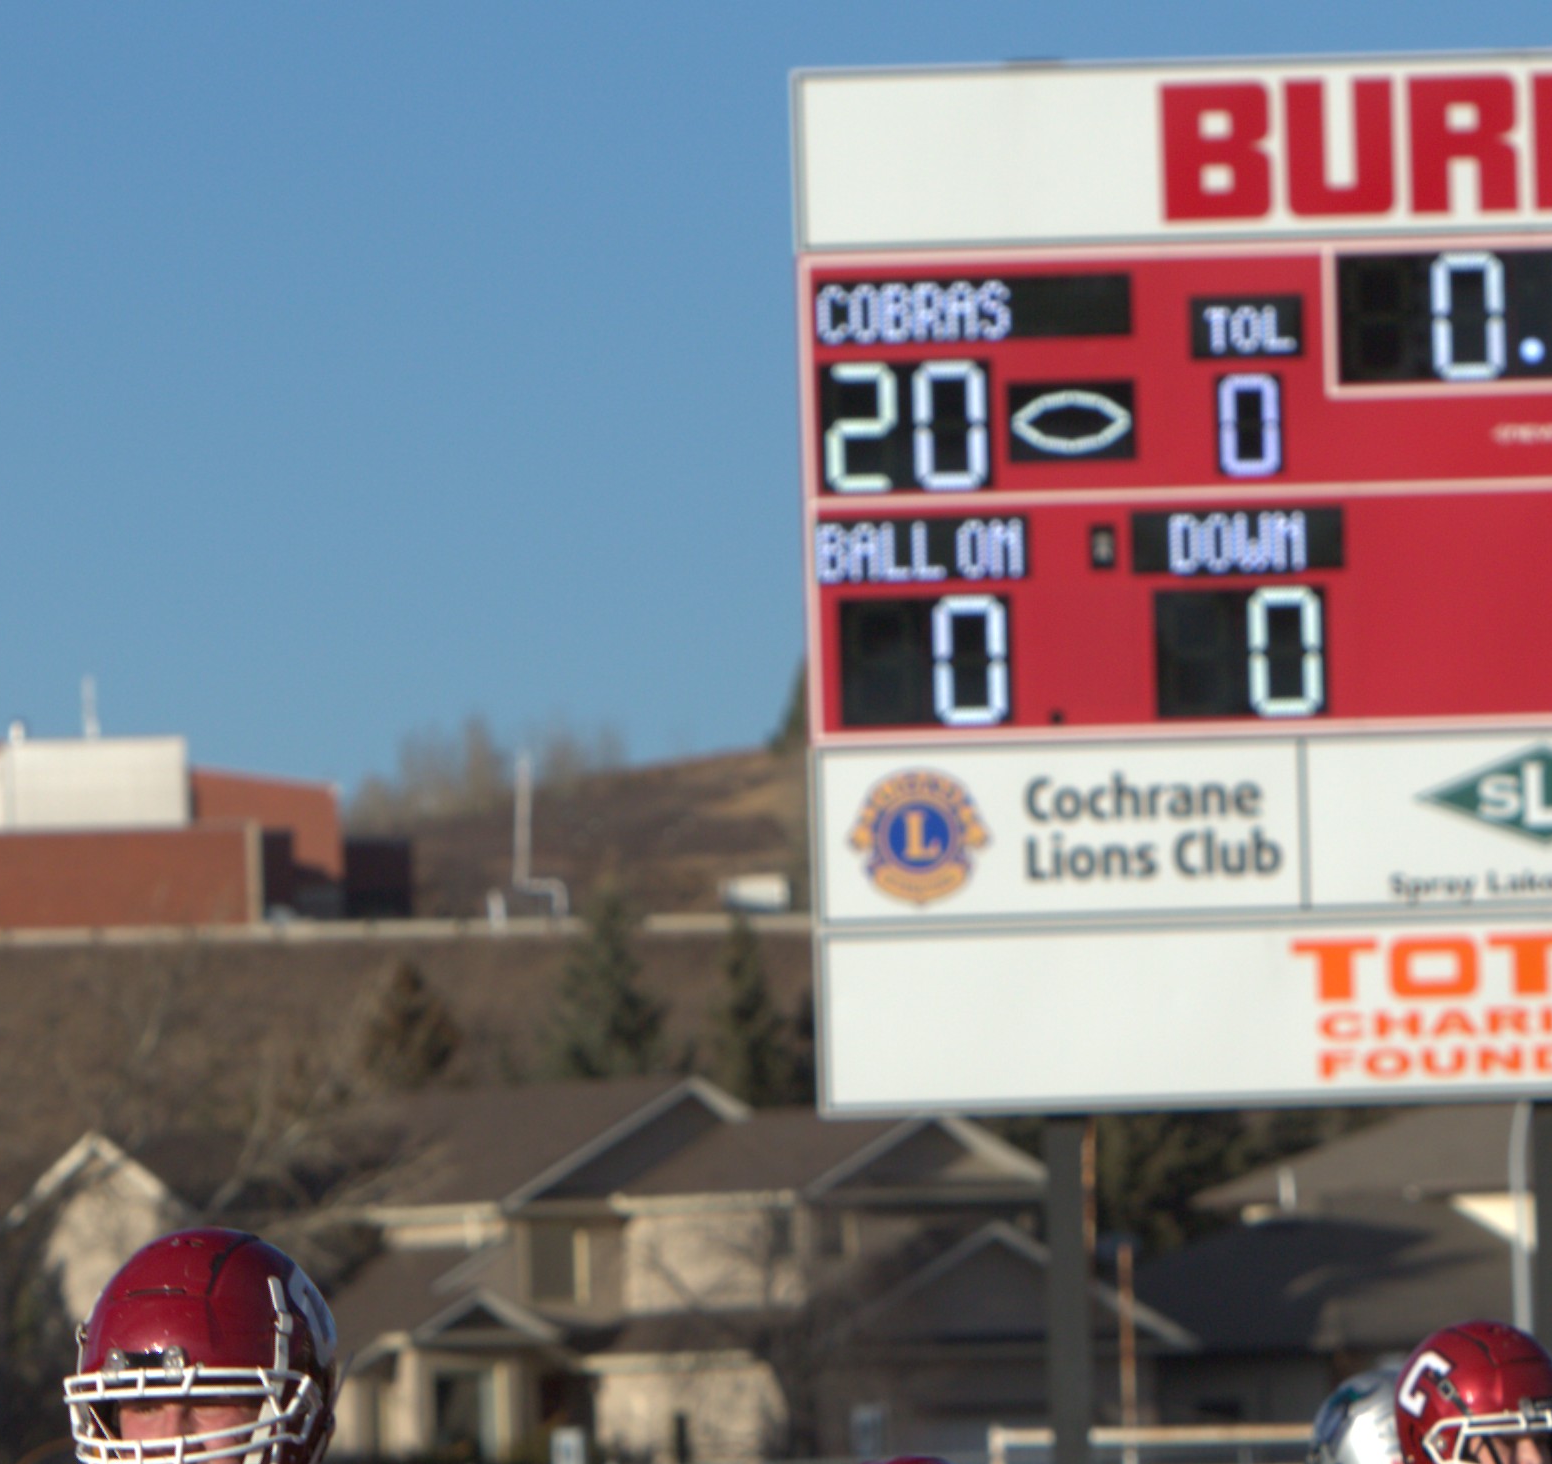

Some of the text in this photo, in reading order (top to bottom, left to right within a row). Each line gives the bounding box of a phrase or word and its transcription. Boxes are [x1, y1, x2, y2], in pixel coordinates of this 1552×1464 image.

[817, 281, 1010, 345] COBRAS
[1203, 305, 1298, 353] TOL
[826, 361, 987, 490] 20
[1218, 374, 1281, 477] 0
[817, 518, 1024, 583] BALL ON
[1169, 512, 1307, 575] DOWN
[932, 594, 1009, 725] 0
[1250, 585, 1324, 716] 0
[1025, 771, 1262, 822] Cochrane
[904, 811, 942, 860] L
[1026, 828, 1282, 881] Lions Club
[1389, 870, 1476, 905] Spray
